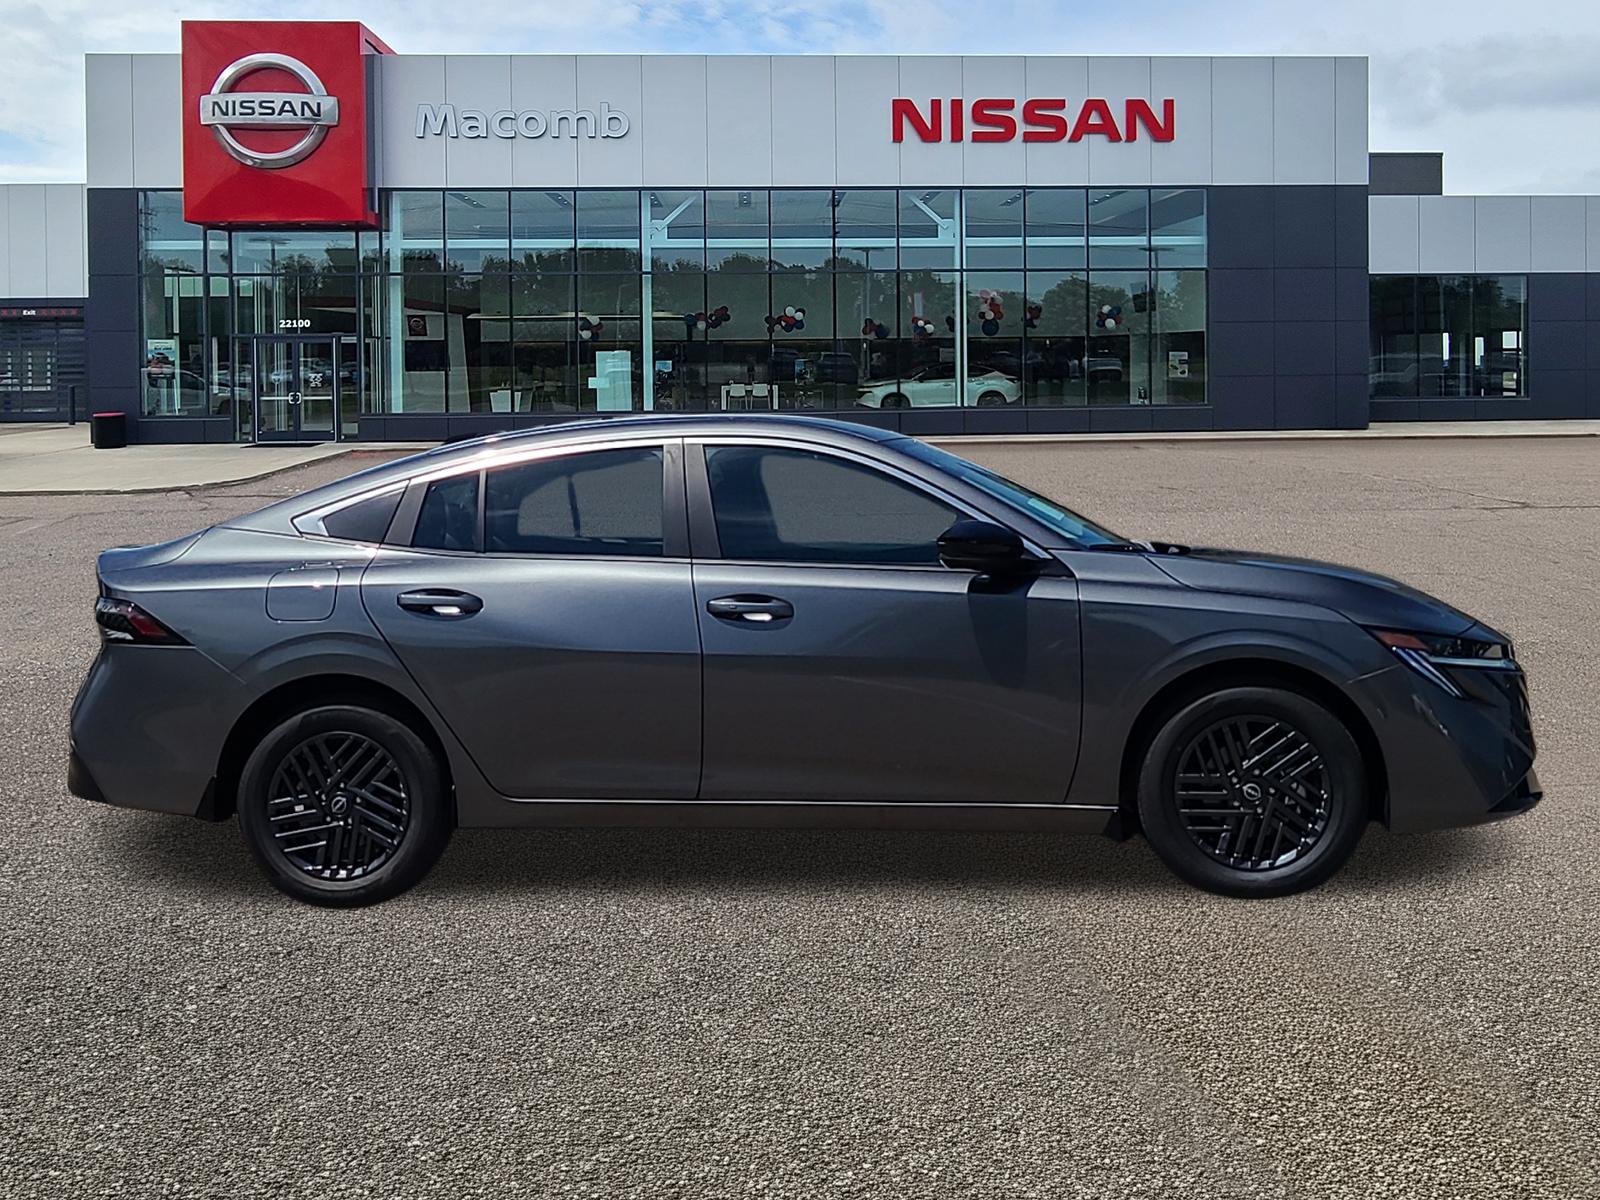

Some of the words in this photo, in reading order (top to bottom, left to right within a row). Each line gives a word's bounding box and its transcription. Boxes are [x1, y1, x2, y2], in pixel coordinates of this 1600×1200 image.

[212, 100, 322, 117] NISSAN
[415, 101, 630, 139] Macomb
[893, 98, 1175, 143] NISSAN
[279, 319, 311, 328] 22100
